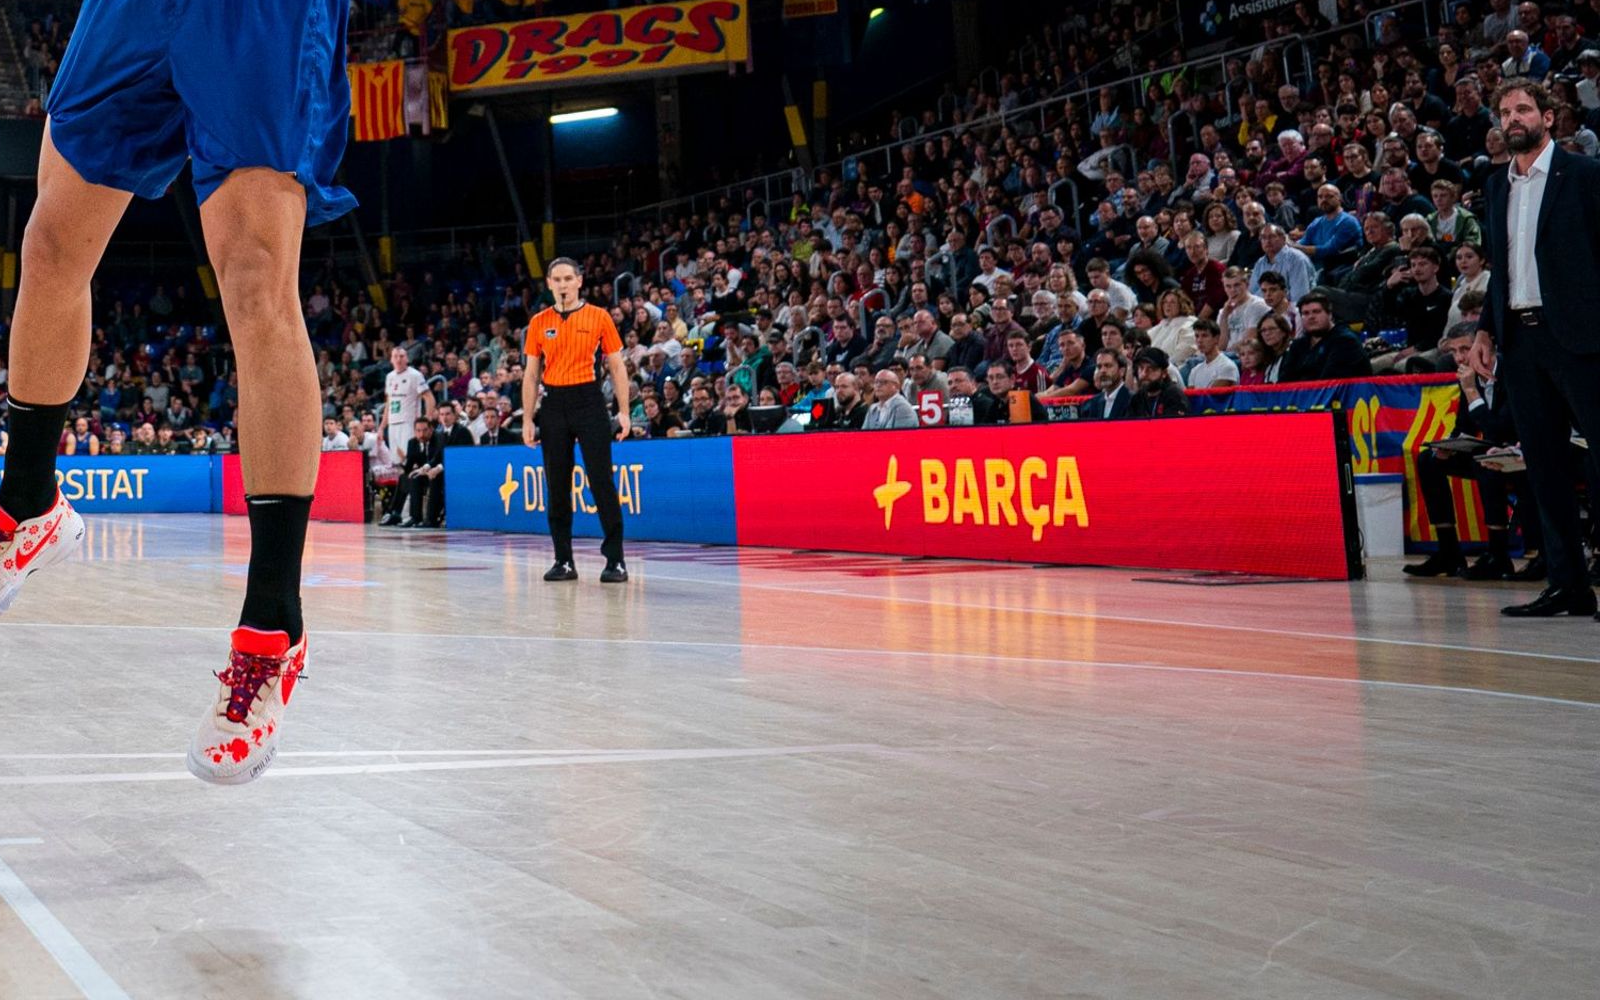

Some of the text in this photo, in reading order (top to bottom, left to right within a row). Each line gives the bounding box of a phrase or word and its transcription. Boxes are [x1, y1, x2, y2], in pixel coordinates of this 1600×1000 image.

[452, 1, 740, 84] DRACS
[921, 393, 942, 425] 5
[920, 456, 1089, 541] BARÇA
